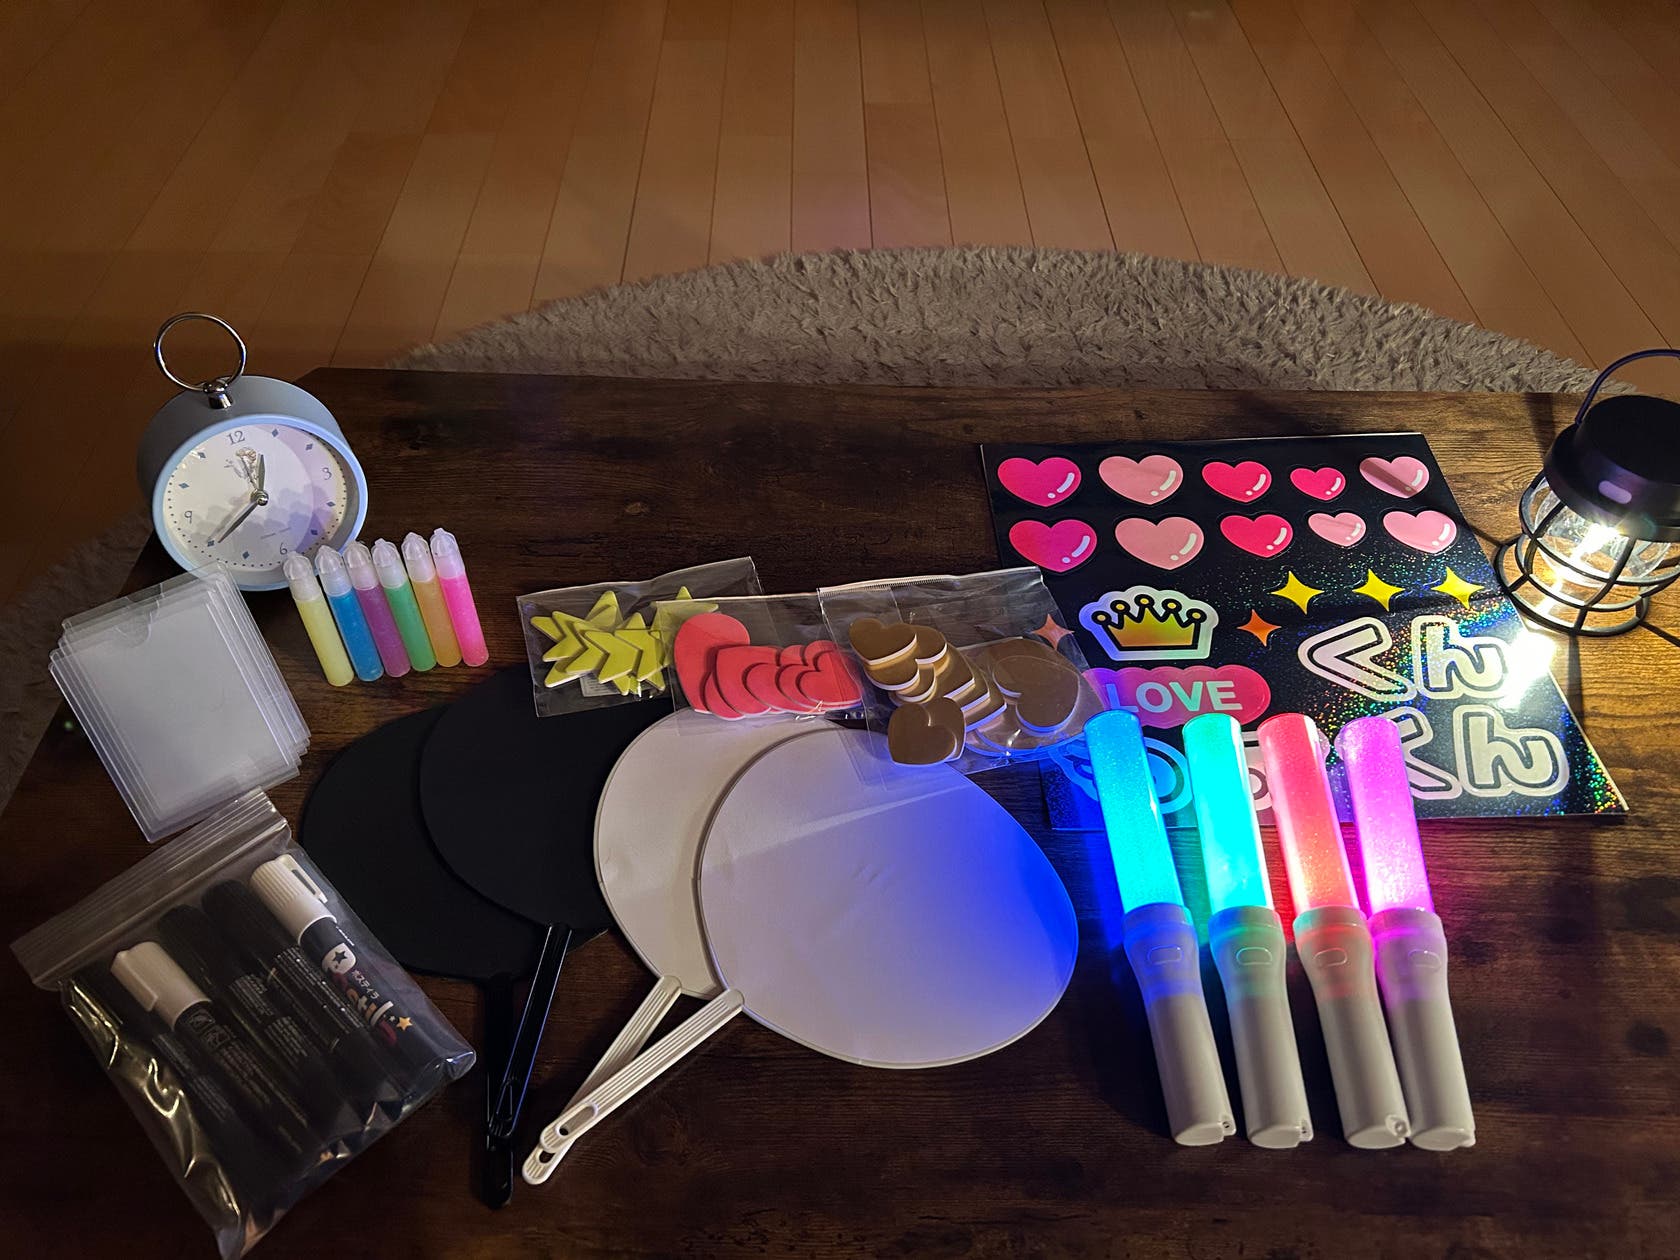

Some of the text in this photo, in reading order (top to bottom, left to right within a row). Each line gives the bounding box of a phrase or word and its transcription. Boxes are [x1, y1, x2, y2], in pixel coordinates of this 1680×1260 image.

[227, 430, 246, 446] 12
[321, 467, 333, 481] 3
[184, 510, 193, 525] 9
[279, 542, 288, 556] 6
[1300, 616, 1512, 701] くん
[1105, 680, 1243, 714] LOVE
[351, 969, 380, 1000] ポスティラ
